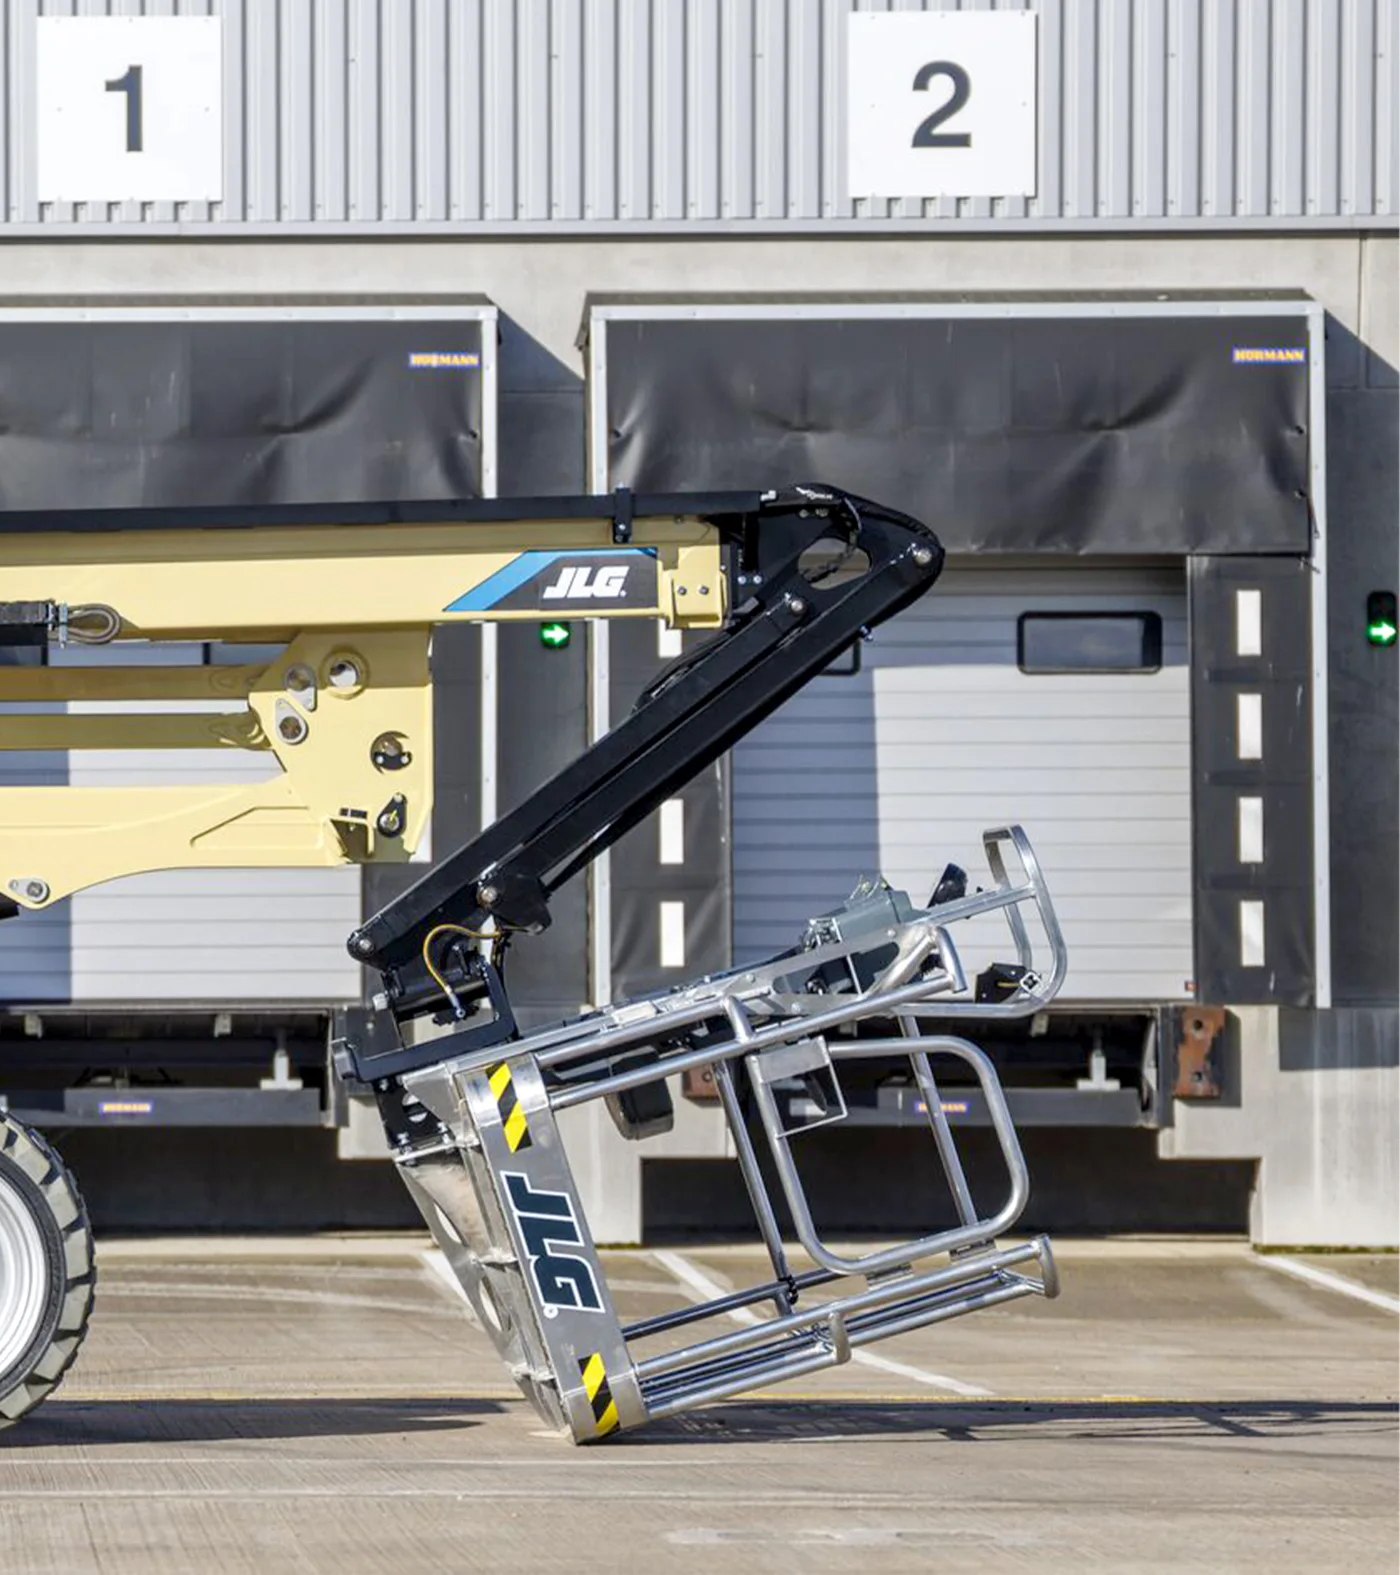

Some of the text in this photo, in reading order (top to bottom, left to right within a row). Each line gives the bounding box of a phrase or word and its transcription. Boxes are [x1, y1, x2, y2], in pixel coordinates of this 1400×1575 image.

[104, 64, 143, 152] 1
[911, 60, 972, 148] 2
[543, 566, 630, 598] JLG
[500, 1170, 606, 1318] JLG
